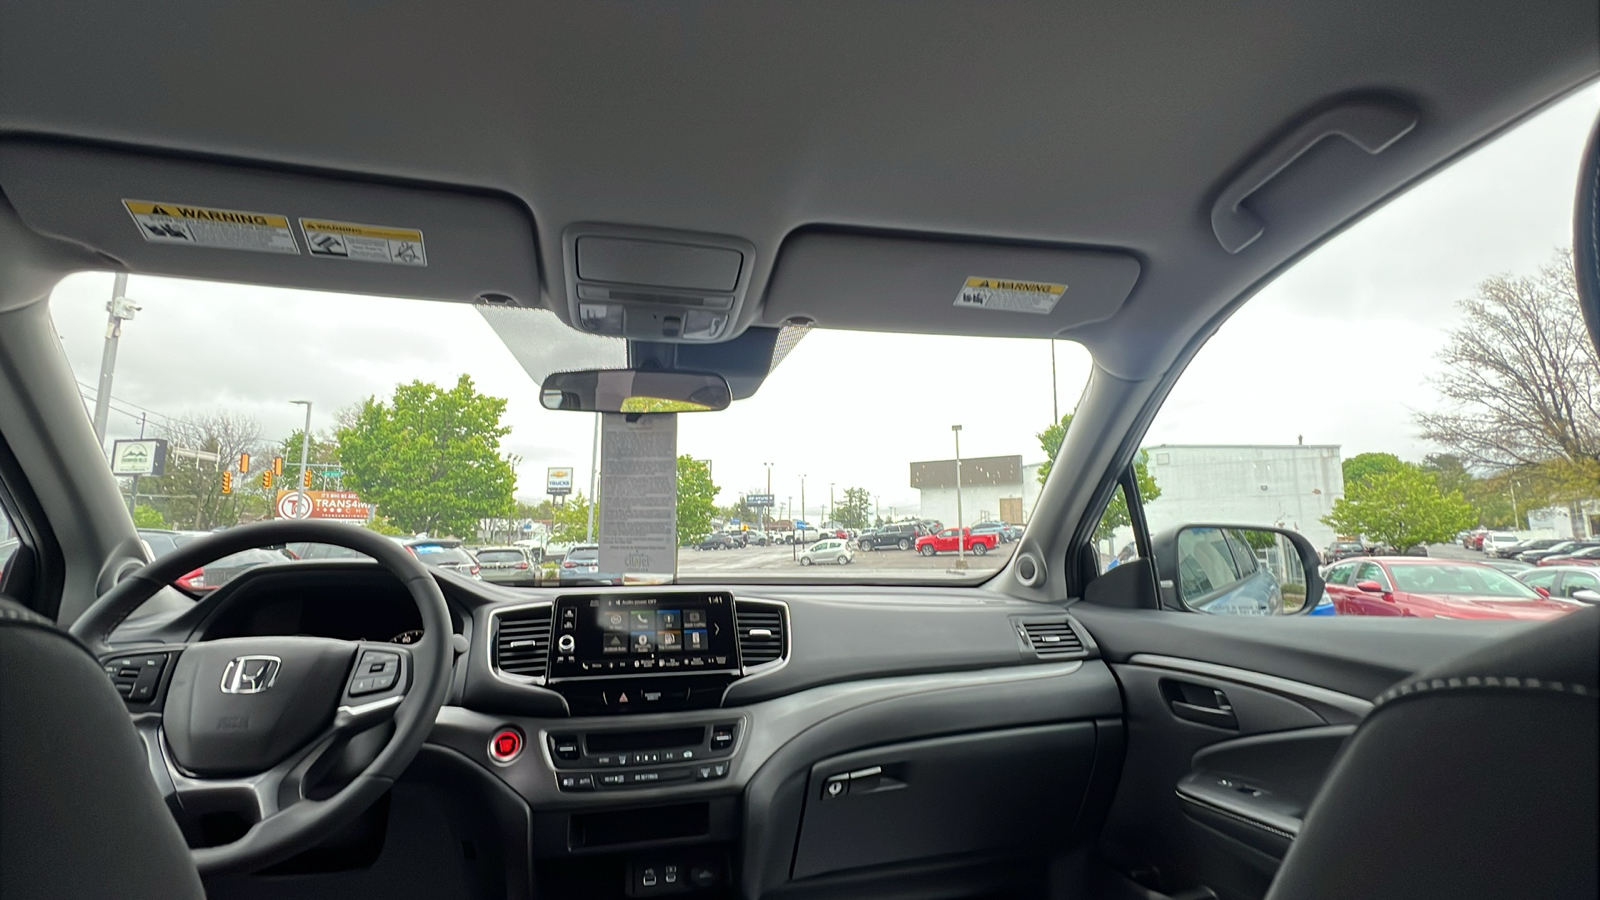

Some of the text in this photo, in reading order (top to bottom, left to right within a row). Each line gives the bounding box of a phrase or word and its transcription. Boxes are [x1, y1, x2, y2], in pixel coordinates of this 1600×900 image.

[176, 207, 268, 226] WARNING
[316, 223, 362, 234] WARNING
[996, 281, 1052, 293] WARNING
[708, 596, 723, 604] 1:41
[402, 635, 411, 643] 60
